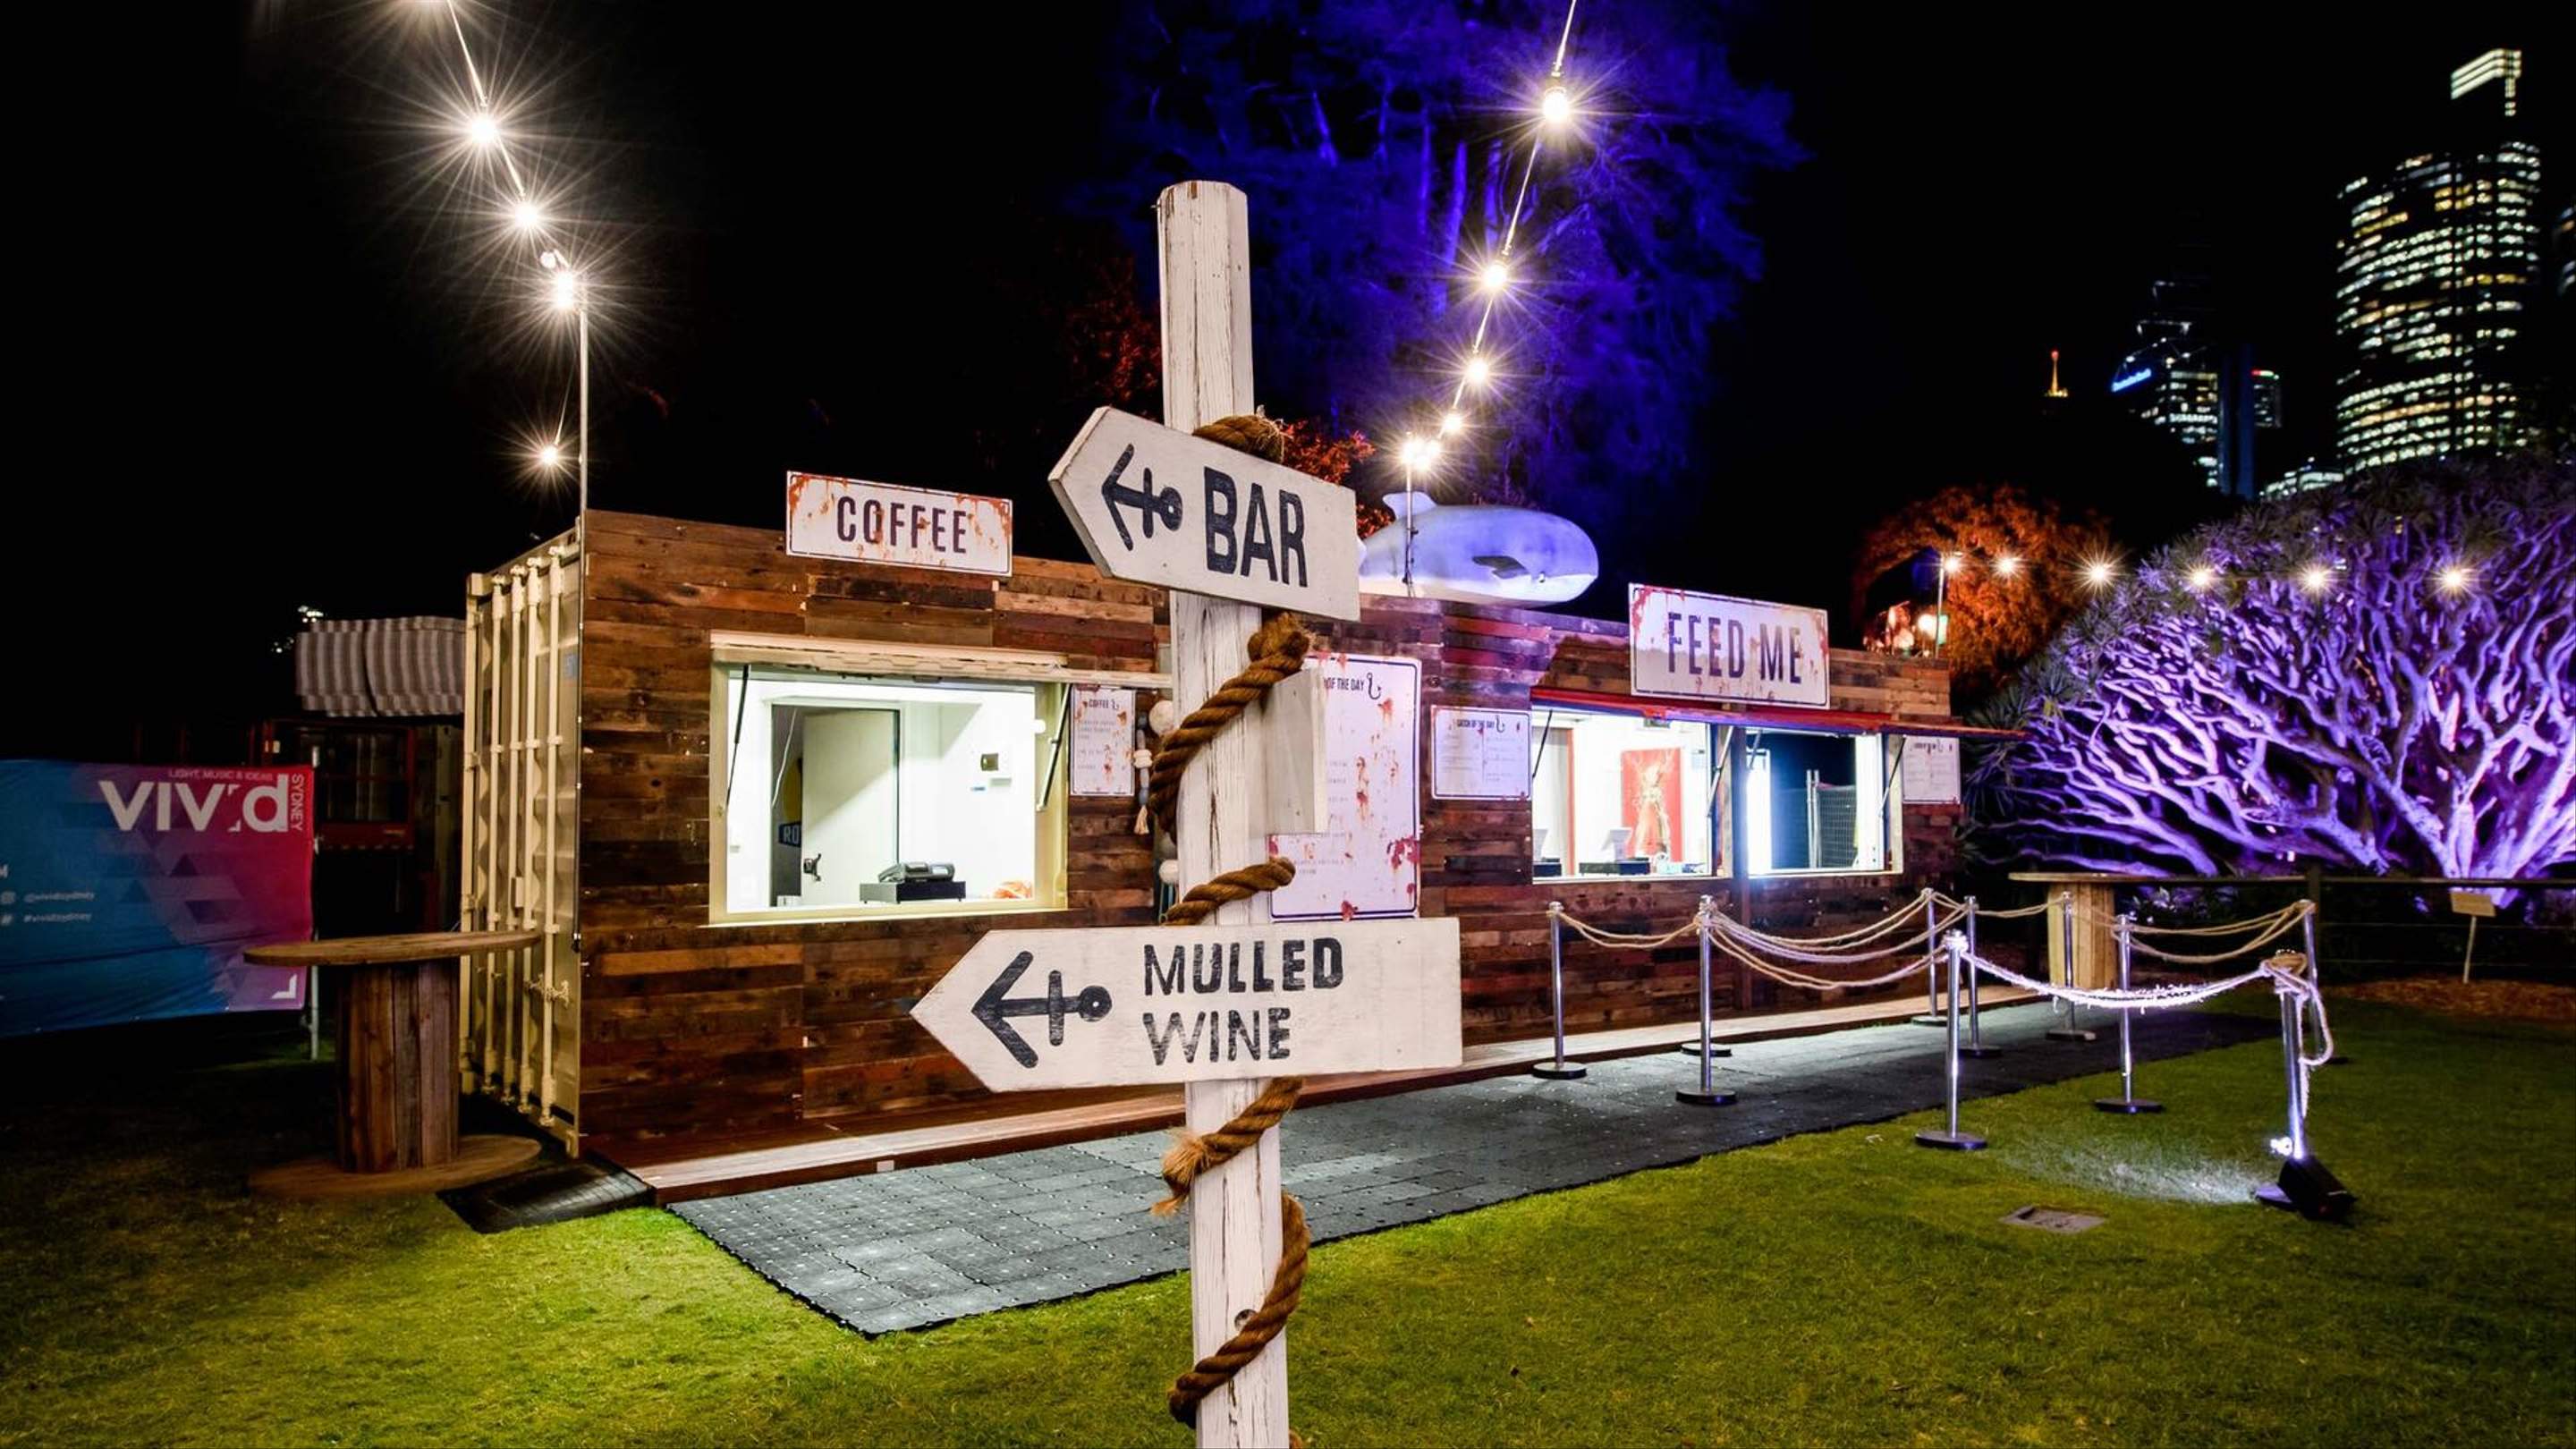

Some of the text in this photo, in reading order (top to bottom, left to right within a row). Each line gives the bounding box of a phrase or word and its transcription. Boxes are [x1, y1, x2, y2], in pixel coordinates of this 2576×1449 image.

[837, 496, 967, 554] COFFEE
[1204, 466, 1308, 588] BAR
[1668, 612, 1801, 684] FEED ME
[1337, 677, 1349, 691] THE
[1351, 678, 1365, 691] DAY
[291, 773, 305, 832] SYDNEY
[1143, 936, 1343, 996] MULLED
[1142, 1008, 1292, 1066] WINE
